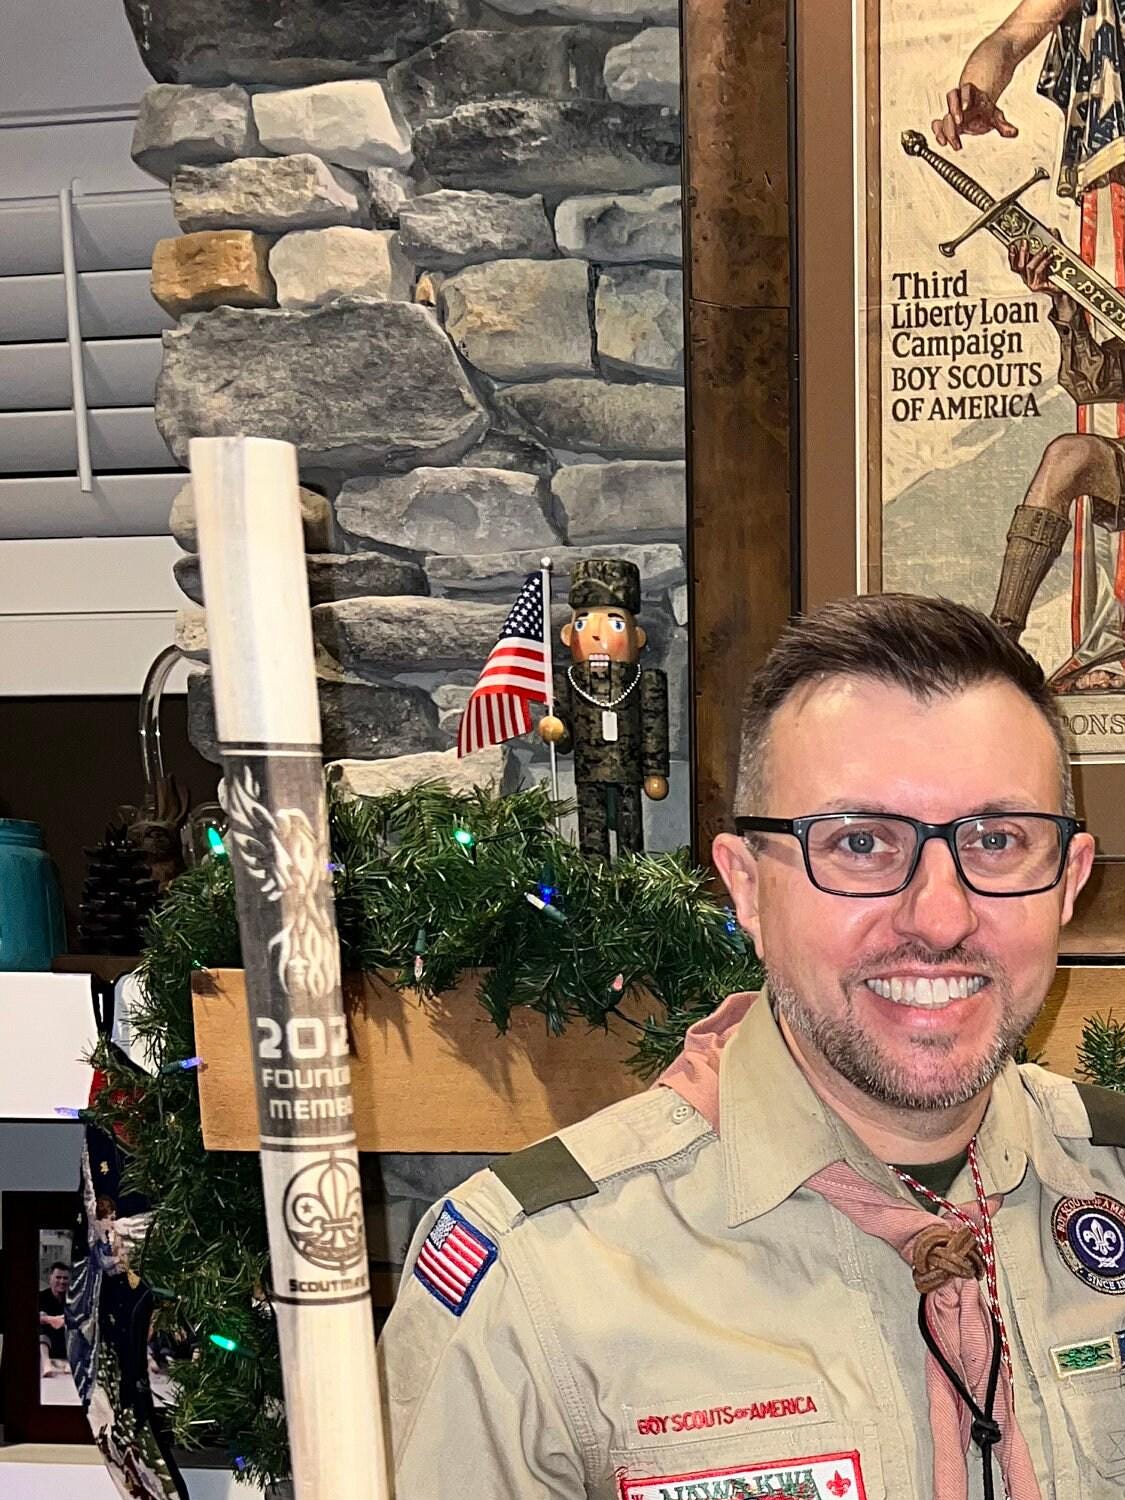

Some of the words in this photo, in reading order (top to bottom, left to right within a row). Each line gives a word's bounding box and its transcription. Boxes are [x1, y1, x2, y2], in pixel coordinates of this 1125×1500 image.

[892, 269, 969, 300] Third
[891, 301, 977, 331] Liberty
[980, 298, 1039, 324] Loan
[892, 328, 1023, 361] Campaign
[891, 366, 942, 391] BOY
[948, 362, 1042, 389] SCOUTS
[891, 398, 925, 422] OF
[928, 393, 1041, 421] AMERICA
[1087, 1273, 1116, 1290] SINCE
[637, 1415, 669, 1435] BOY
[671, 1405, 735, 1432] SCOUTS
[750, 1396, 818, 1420] AMERICA
